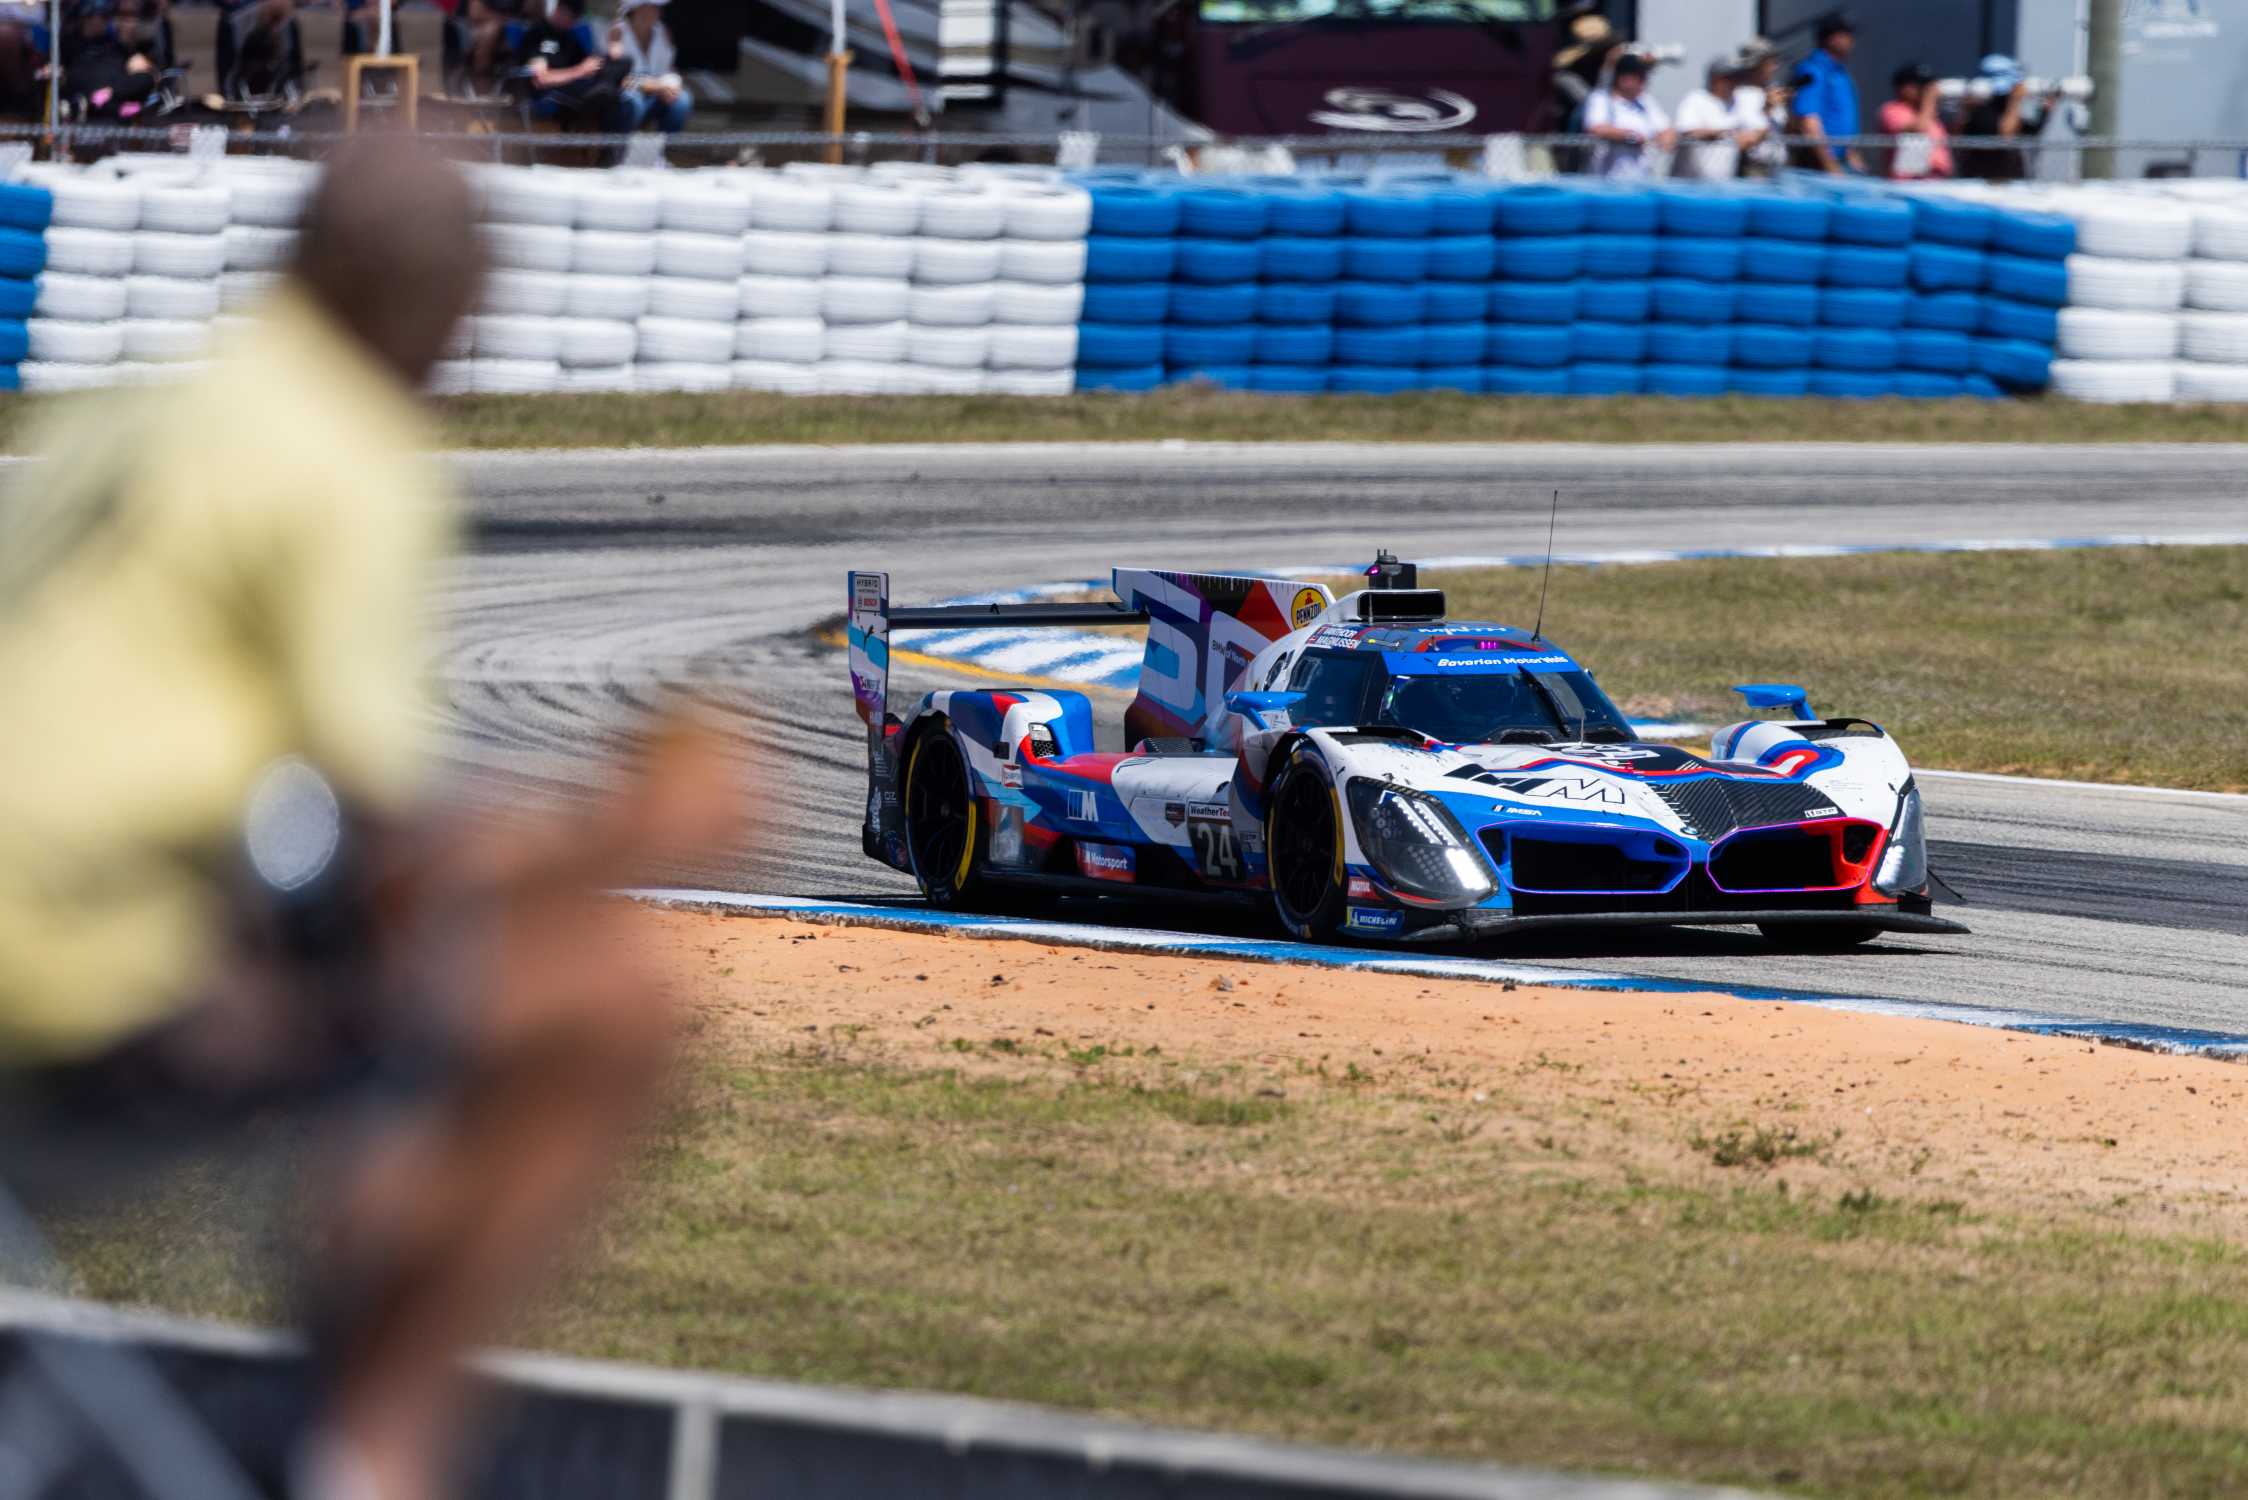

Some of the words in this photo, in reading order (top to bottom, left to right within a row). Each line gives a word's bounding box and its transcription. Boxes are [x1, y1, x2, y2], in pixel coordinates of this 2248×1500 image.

[1296, 602, 1321, 624] PENNZO
[1437, 658, 1502, 667] Bavarian
[1502, 656, 1542, 665] Motor
[1190, 804, 1230, 817] WeatherTe
[1506, 807, 1543, 816] IMSA
[1197, 822, 1237, 879] 24
[1091, 851, 1128, 870] Motorsport
[1359, 914, 1398, 926] MICHELIN
